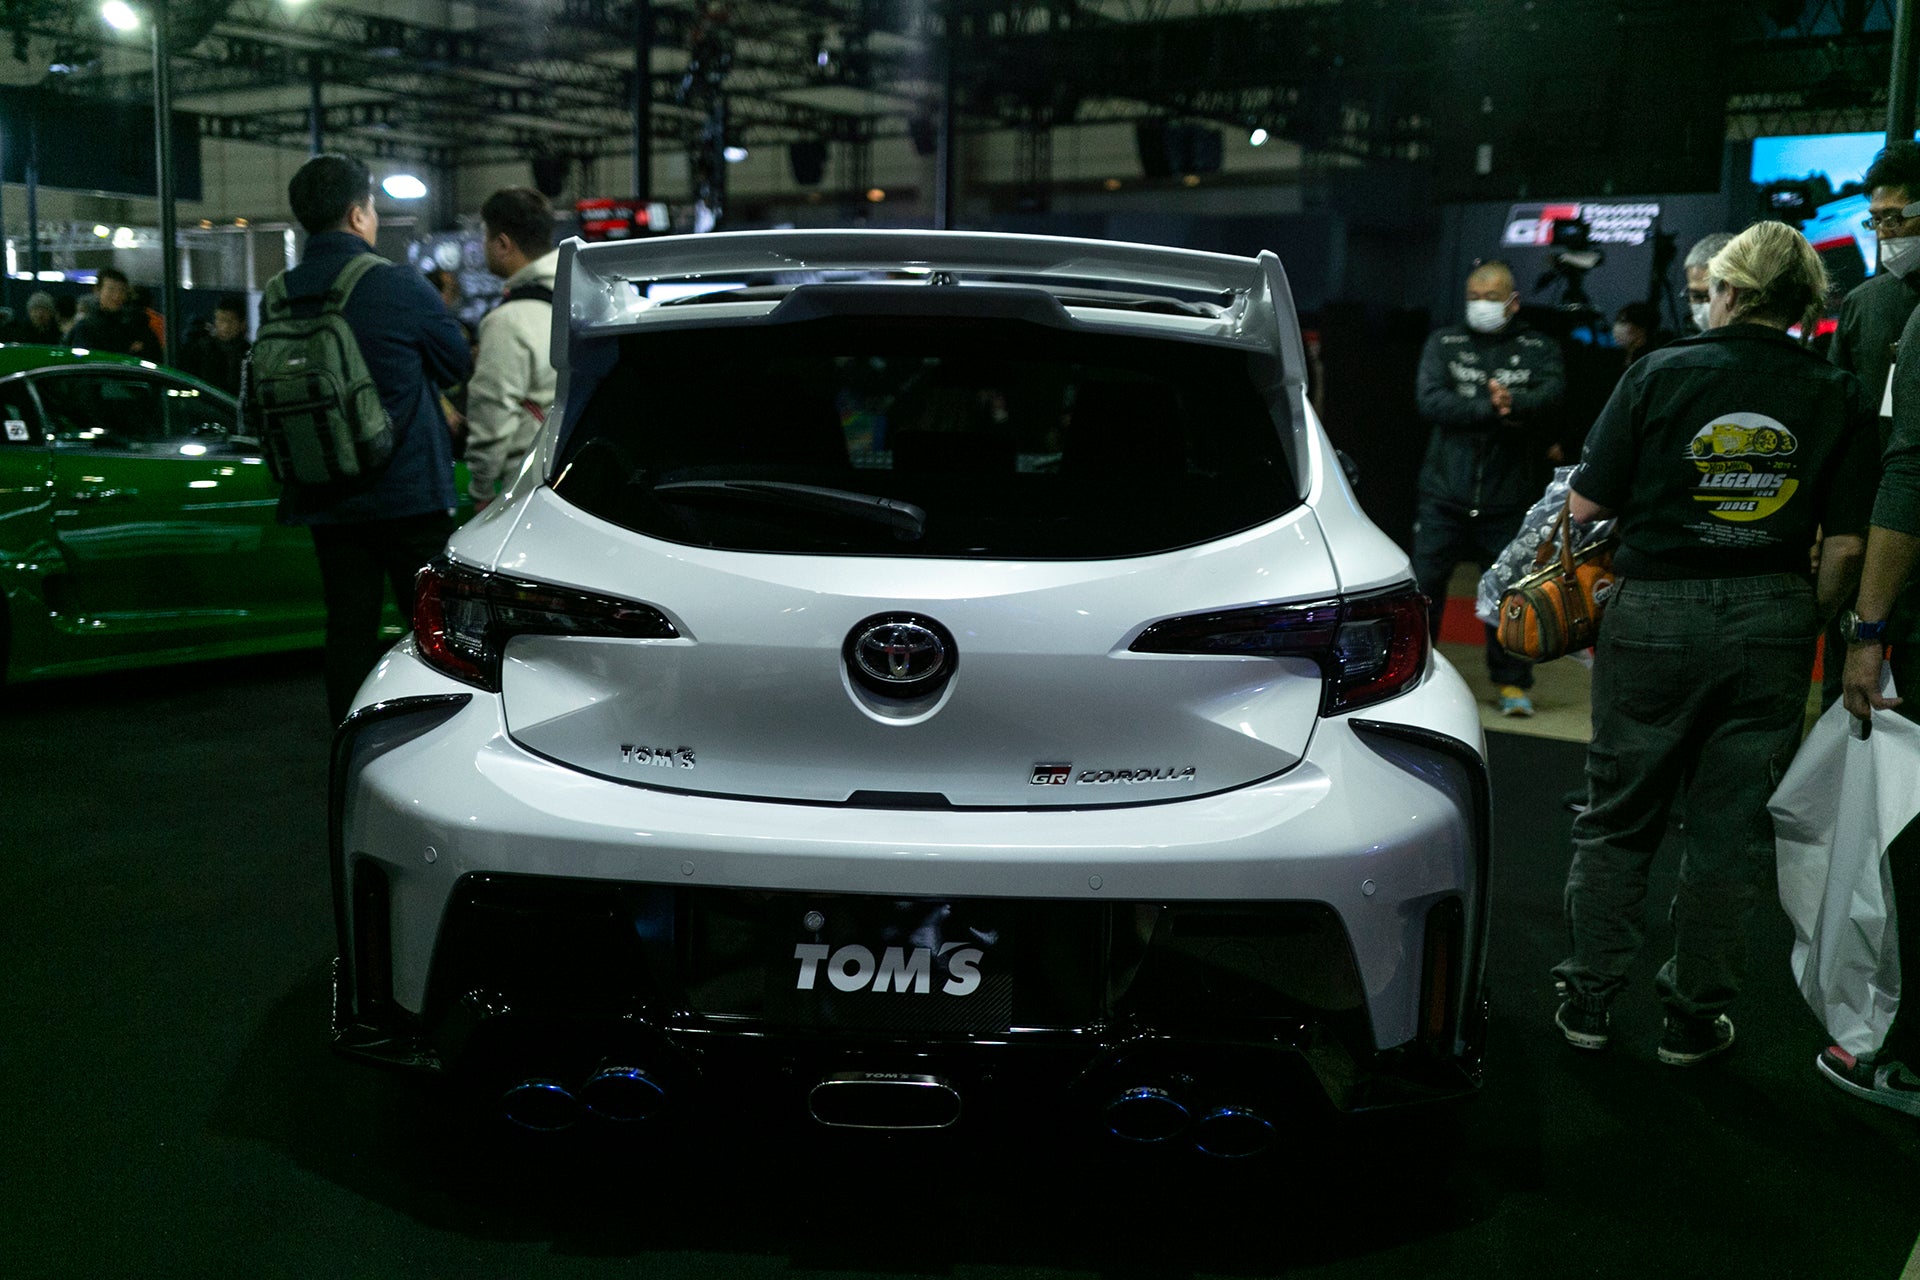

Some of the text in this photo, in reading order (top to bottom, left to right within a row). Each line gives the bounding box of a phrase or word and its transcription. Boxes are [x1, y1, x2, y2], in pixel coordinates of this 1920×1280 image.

[1698, 473, 1787, 488] LEGENDS
[1716, 501, 1756, 511] JUDGE
[1075, 767, 1197, 785] COROLLA
[794, 942, 984, 996] TOM'S
